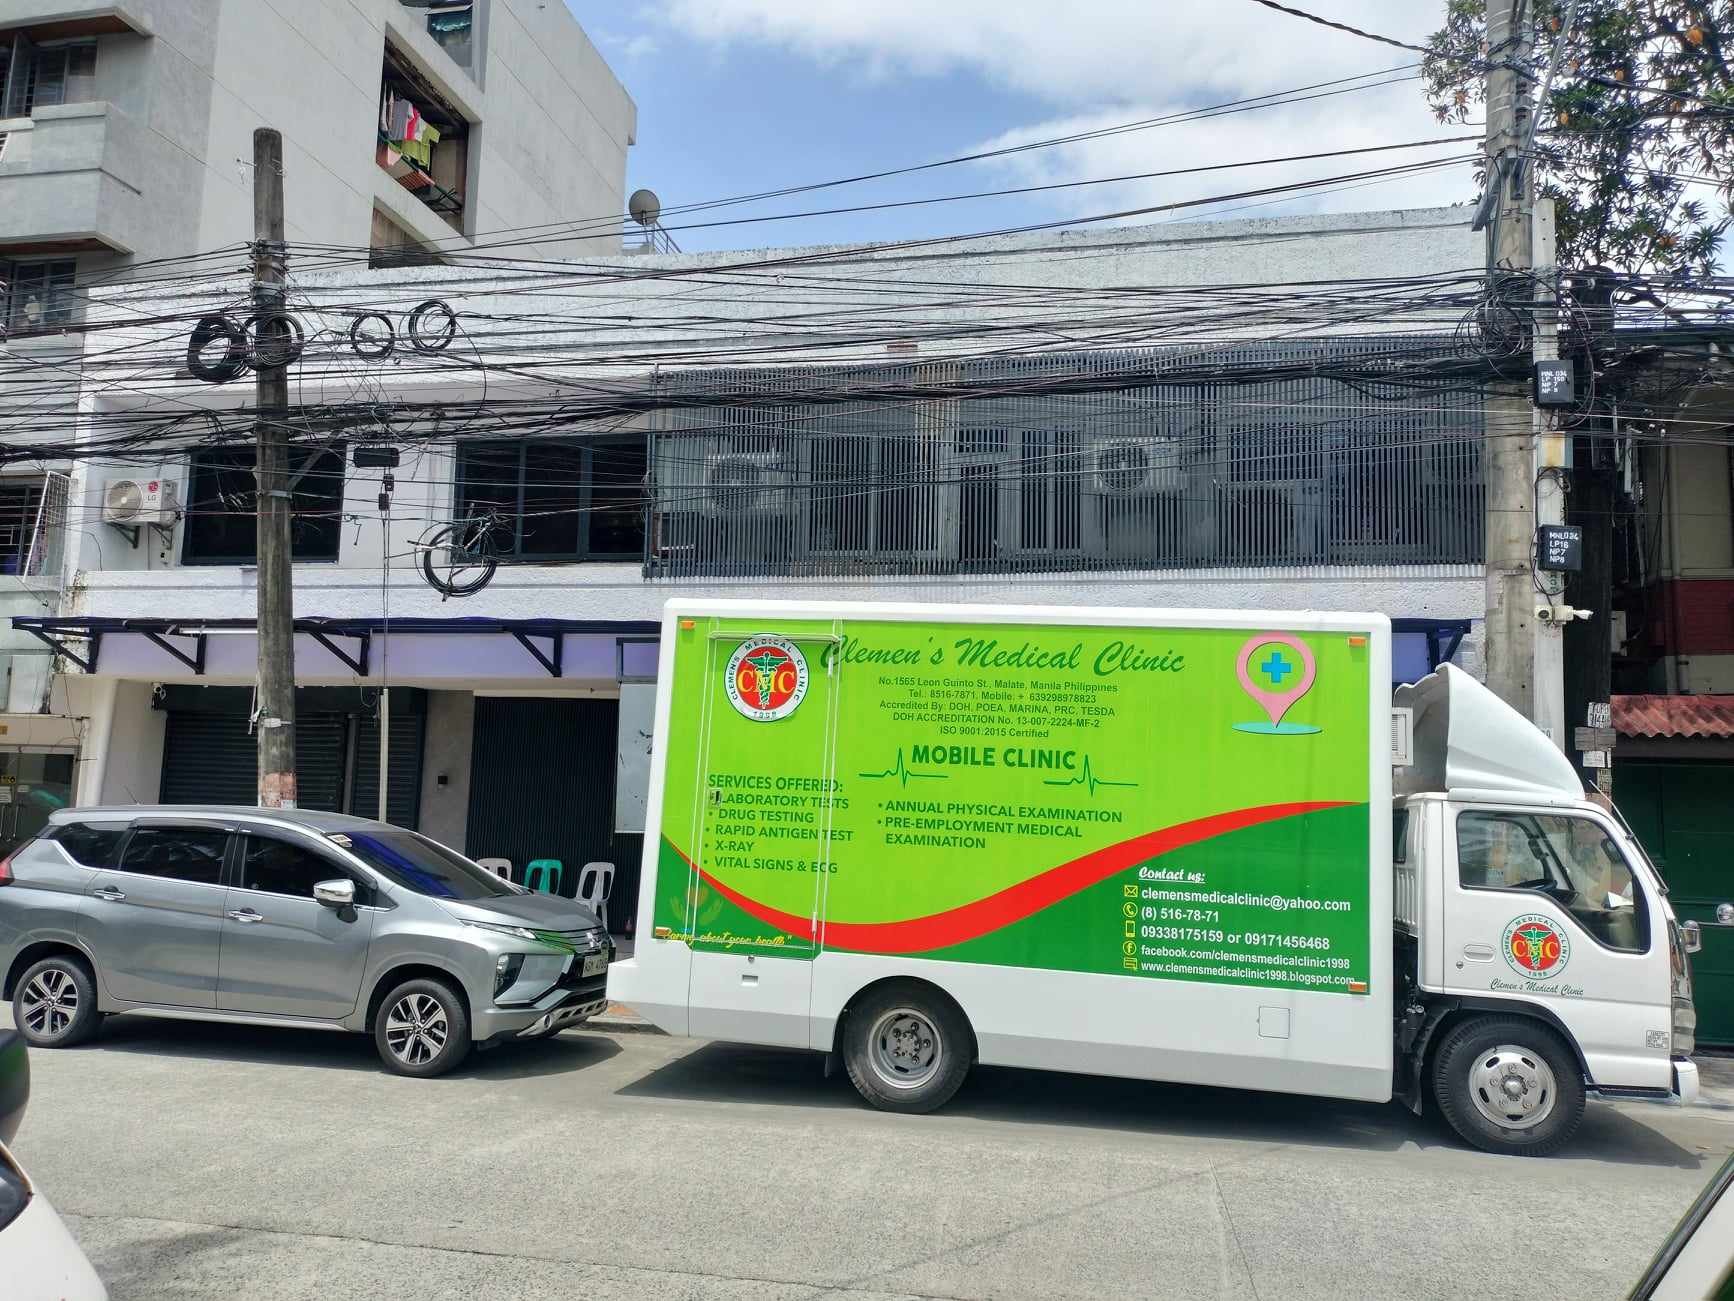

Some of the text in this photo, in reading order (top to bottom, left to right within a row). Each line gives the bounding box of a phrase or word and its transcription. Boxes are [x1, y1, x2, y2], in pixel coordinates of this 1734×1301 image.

[820, 635, 1185, 676] Clemen's Medical Clinic
[917, 678, 940, 687] Leon
[943, 679, 974, 688] Guinto
[1030, 681, 1061, 690] Manila
[1064, 682, 1118, 694] Philippines
[879, 700, 929, 711] Accredited
[1081, 707, 1116, 717] TESDA
[893, 712, 914, 721] DOH
[917, 713, 995, 724] ACCREDITATION
[940, 726, 957, 735] ISO
[1009, 728, 1049, 738] Certified
[911, 745, 1077, 769] MOBILE CLINIC
[708, 774, 844, 792] SERVICES OFFERED:
[720, 793, 849, 809] LABORATORY TESTS
[718, 808, 814, 823] DRUG TESTING
[885, 800, 1123, 823] ANNUAL PHYSICAL EXAMINATION
[715, 824, 854, 841] RAPID ANTIGEN TEST
[885, 816, 1083, 838] PRE-EMPLOYMENT MEDICAL
[715, 840, 755, 852] X-RAY
[885, 833, 986, 849] EXAMINATION
[714, 855, 838, 874] VITAL SIGNS & ECG
[1139, 866, 1184, 880] Contact
[1141, 887, 1351, 912] clemensmedicalclinic@yahoo.com
[1141, 906, 1219, 922] (8) 516-78-71
[1141, 925, 1330, 950] 09338175159 or 09171456468
[1141, 944, 1351, 969] facebook.com/clemensmedicalclinic1998
[1525, 981, 1559, 993] Medical
[1560, 984, 1584, 996] Clinic
